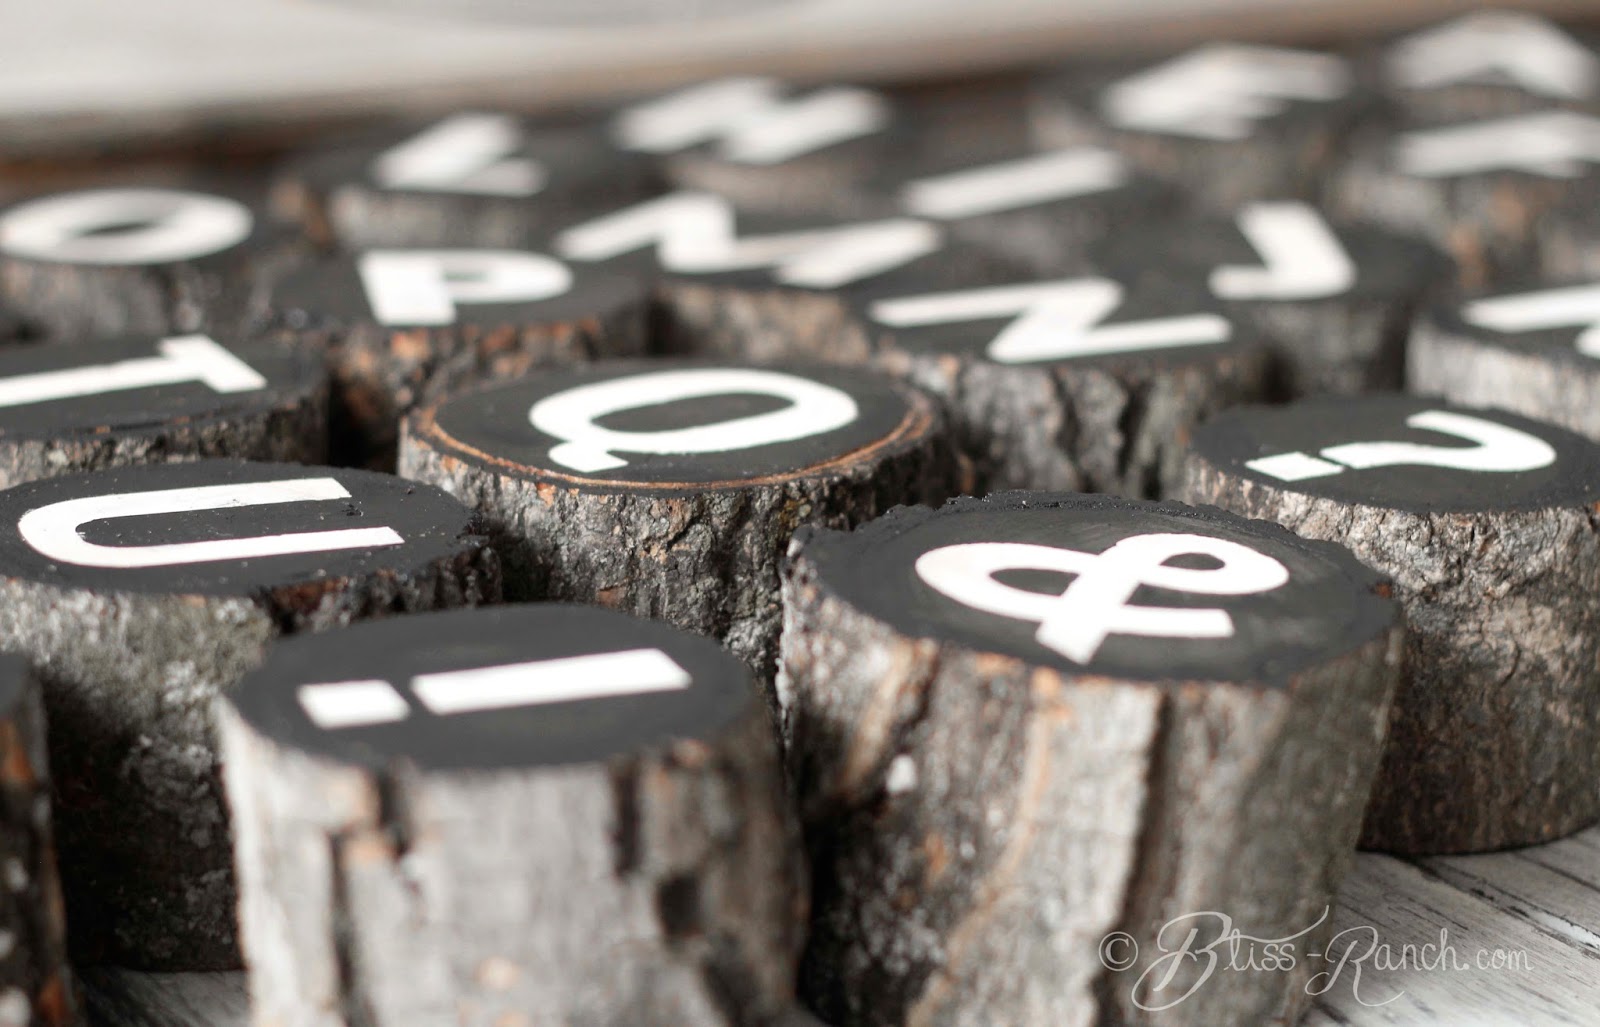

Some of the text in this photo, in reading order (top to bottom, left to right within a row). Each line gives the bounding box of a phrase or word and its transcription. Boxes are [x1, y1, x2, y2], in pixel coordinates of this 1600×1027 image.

[0, 188, 254, 265] O
[558, 192, 943, 288] M
[1209, 201, 1357, 300] J
[359, 248, 574, 328] P
[529, 368, 859, 474] Q
[1245, 409, 1557, 482] ?
[17, 476, 405, 569] U
[915, 532, 1290, 665] &
